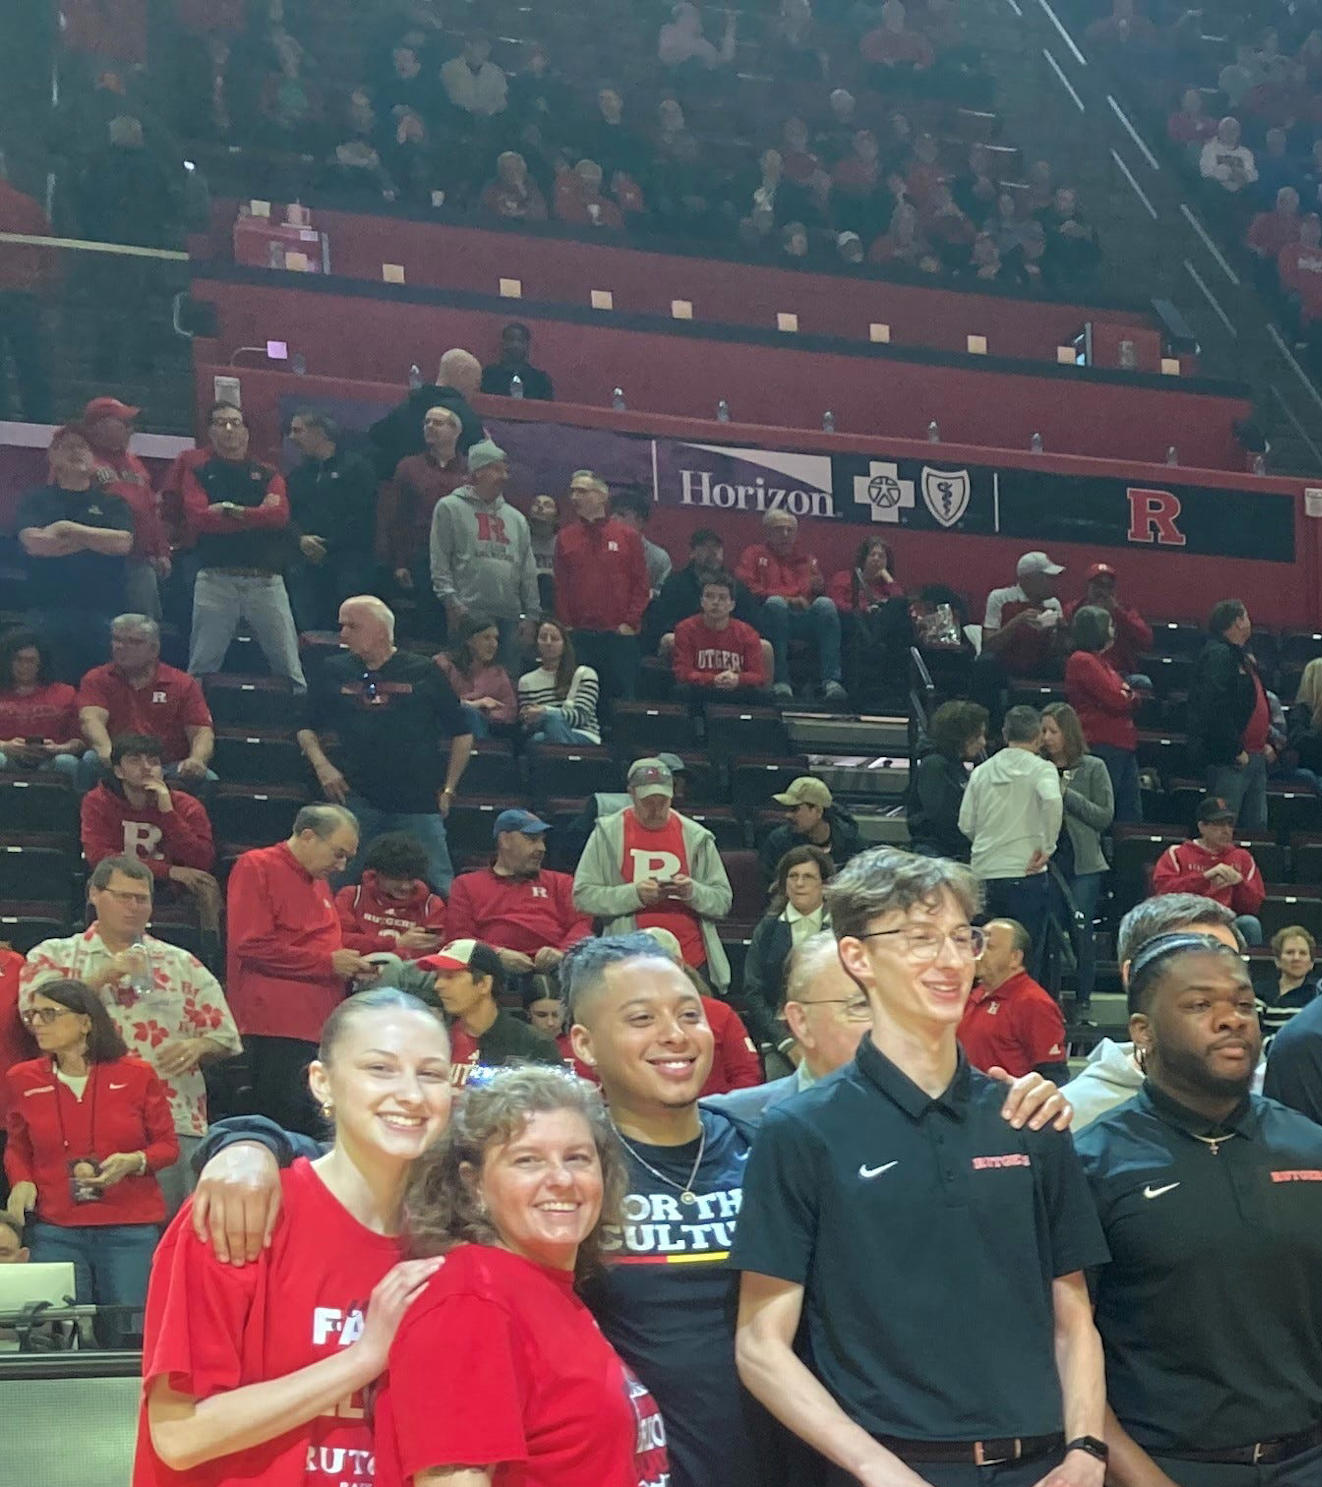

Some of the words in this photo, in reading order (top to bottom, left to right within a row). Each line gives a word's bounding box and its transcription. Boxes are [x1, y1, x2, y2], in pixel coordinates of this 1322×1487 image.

[680, 469, 835, 519] Horizon
[474, 512, 511, 546] R
[1126, 488, 1186, 546] R
[697, 648, 746, 672] UTGER
[152, 691, 167, 703] R
[121, 820, 165, 861] R
[630, 849, 682, 896] R
[532, 886, 548, 898] R
